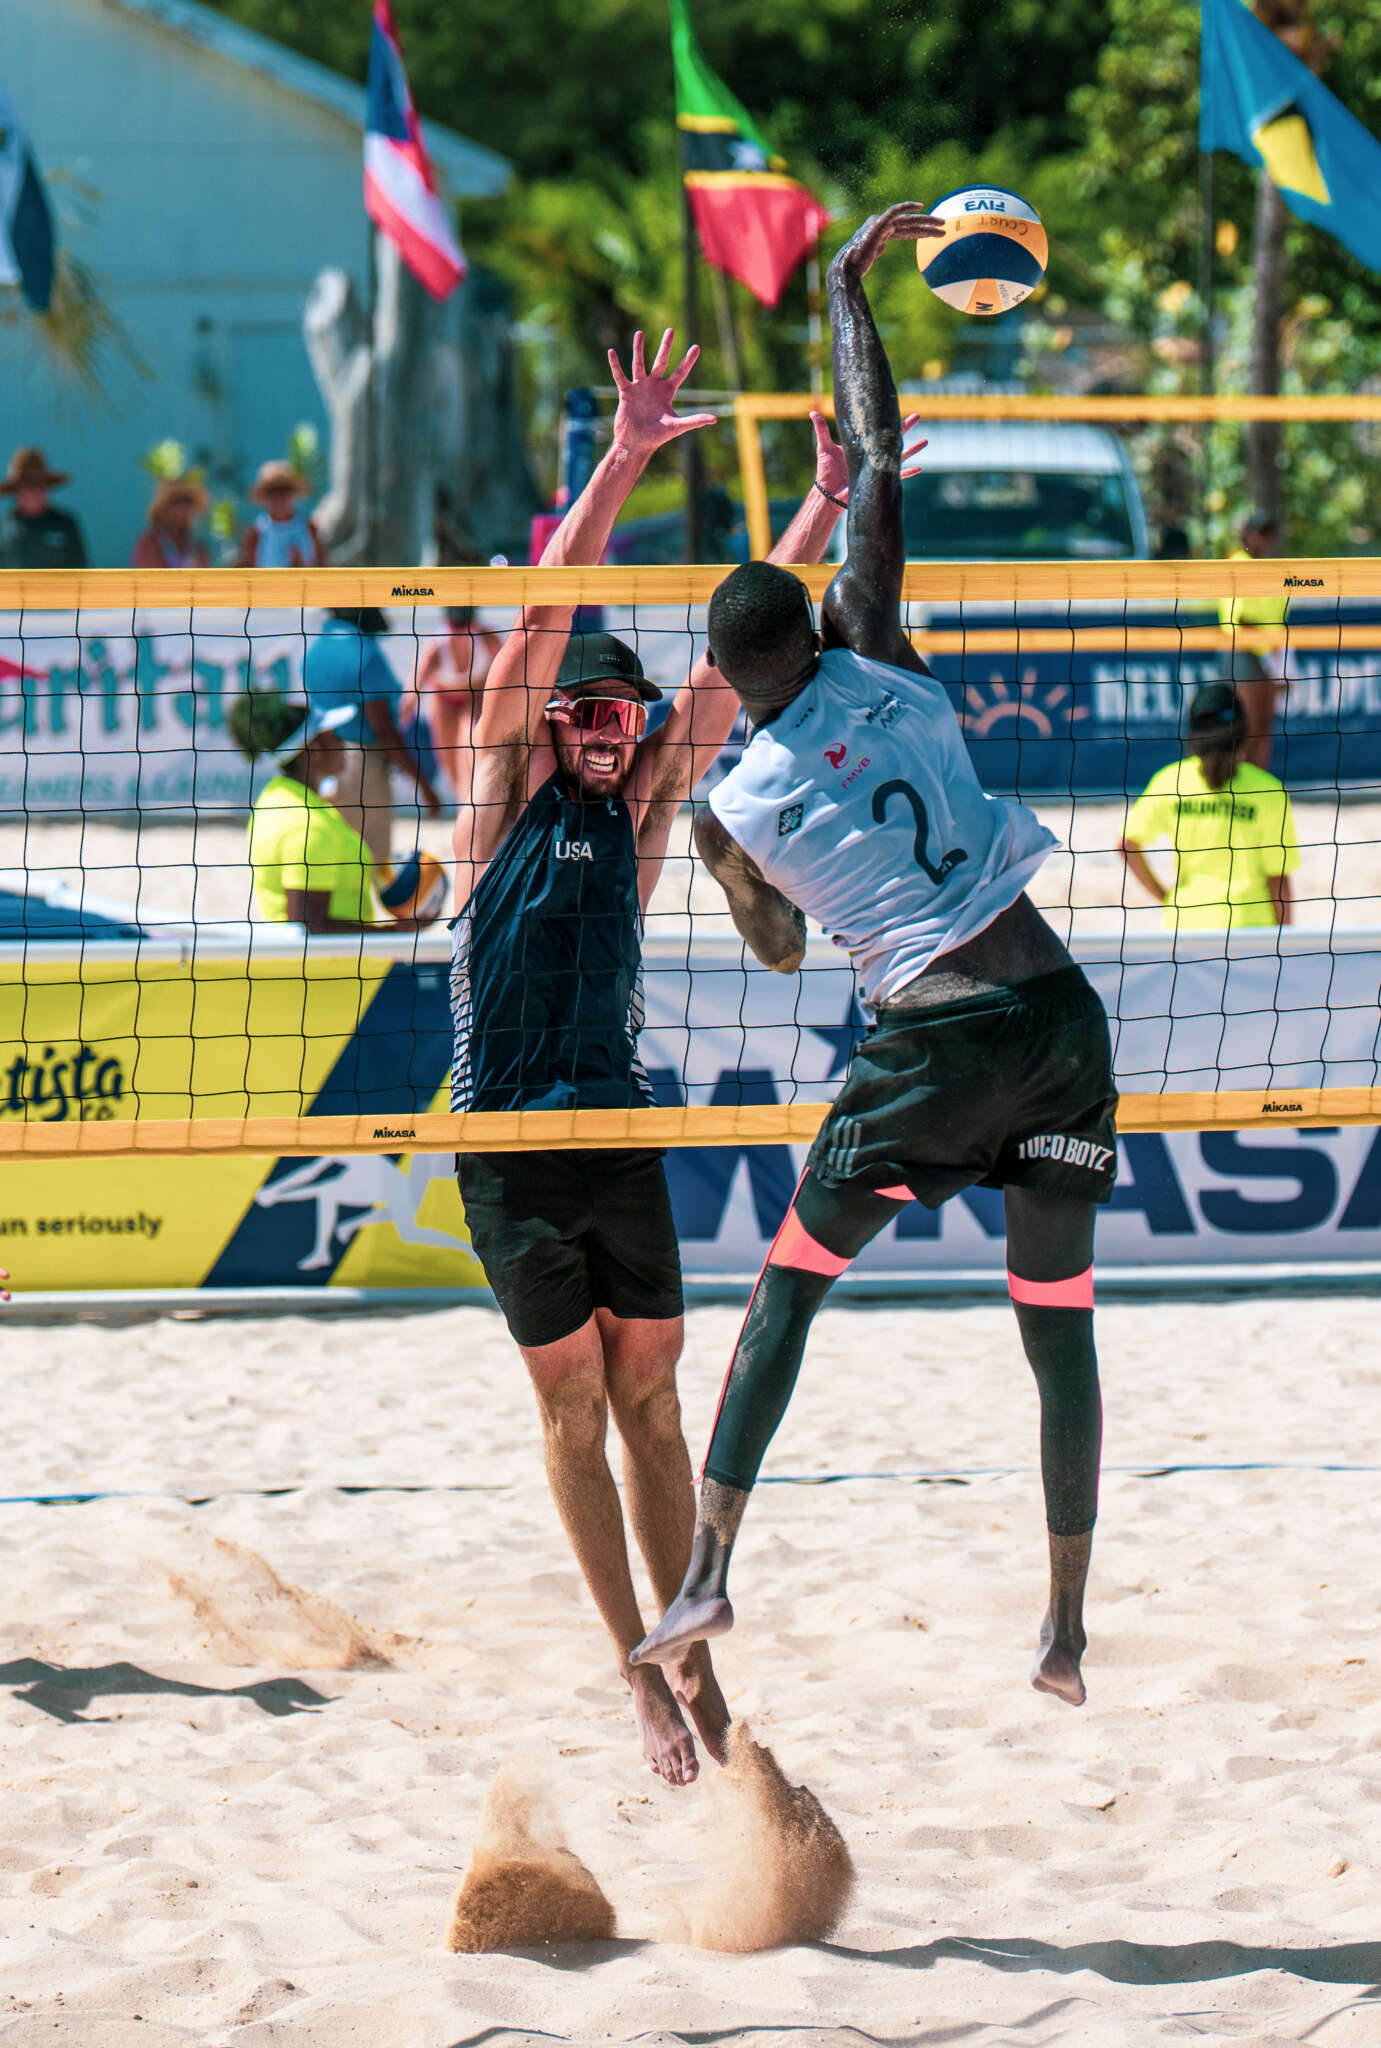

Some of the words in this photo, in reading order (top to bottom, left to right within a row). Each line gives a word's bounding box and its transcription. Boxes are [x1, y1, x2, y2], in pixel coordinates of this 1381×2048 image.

[872, 778, 968, 885] 2
[555, 841, 593, 861] USA
[0, 1046, 123, 1121] tista
[1063, 1137, 1114, 1171] BOYZ
[36, 1210, 163, 1241] seriously
